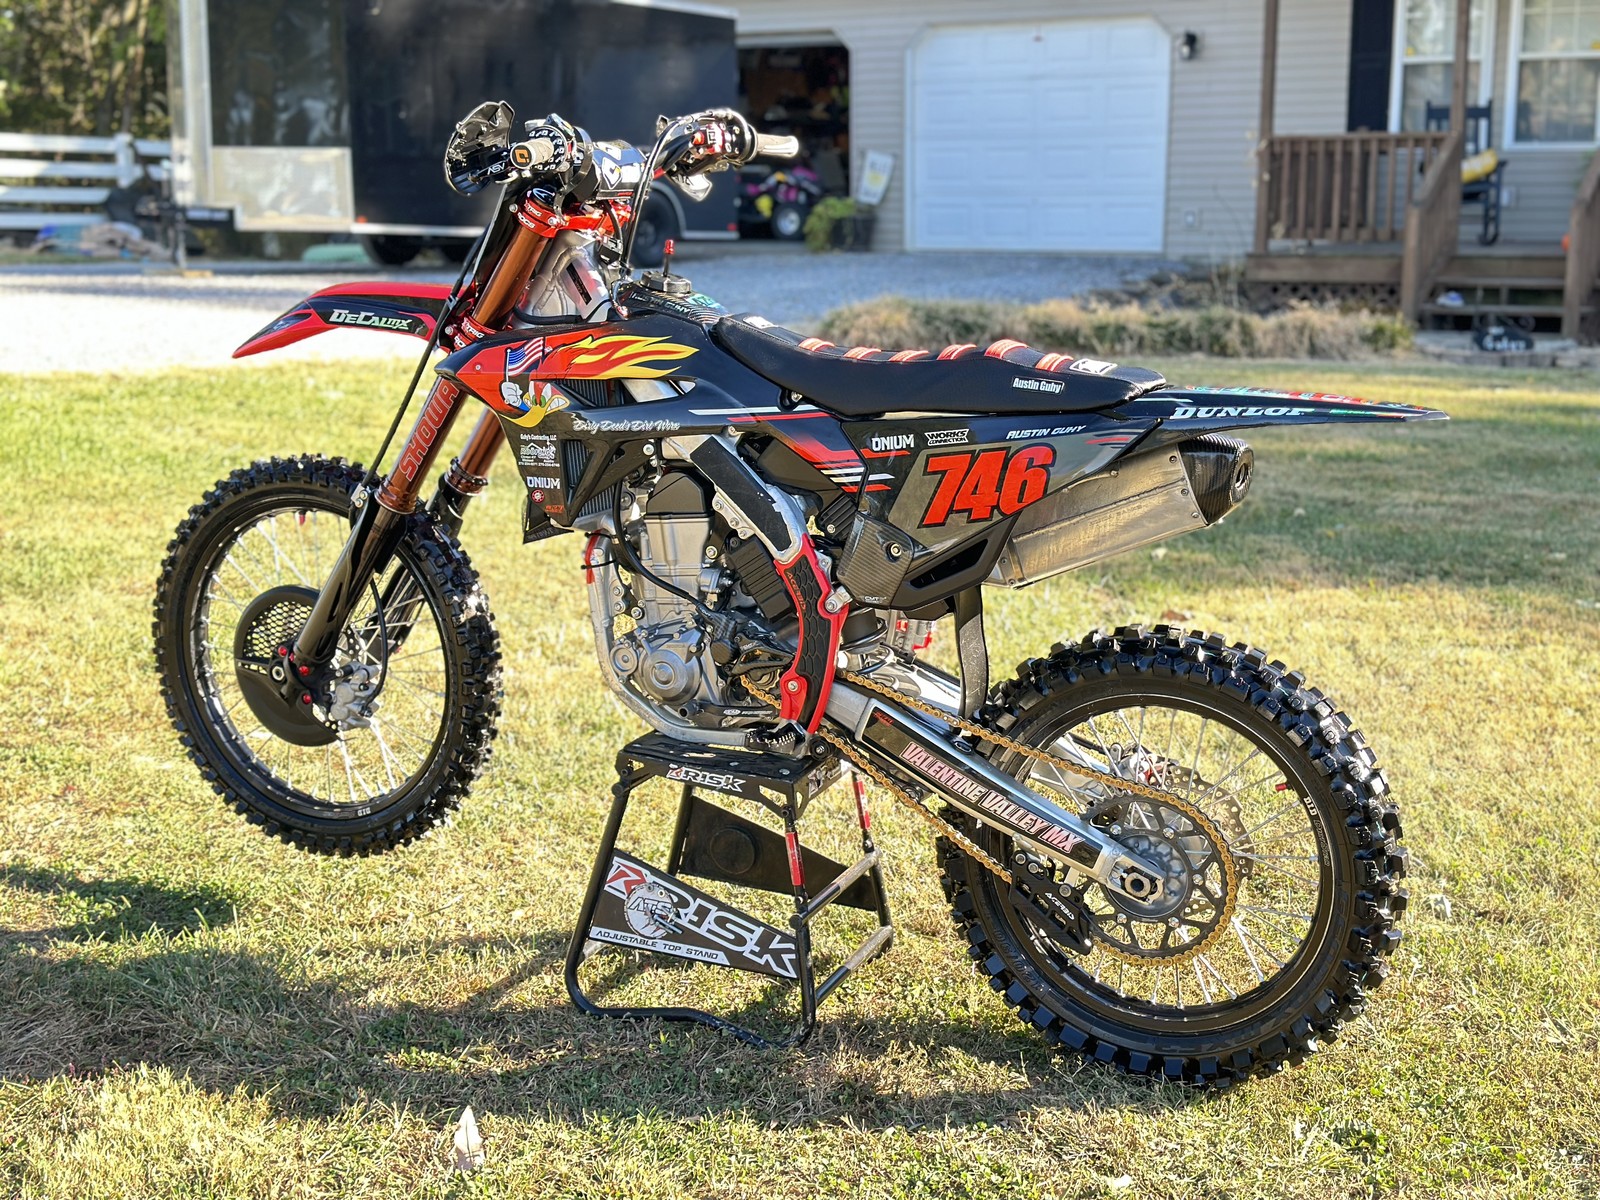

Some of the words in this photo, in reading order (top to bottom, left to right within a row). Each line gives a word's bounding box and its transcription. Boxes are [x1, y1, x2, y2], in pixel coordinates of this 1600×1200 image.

[487, 162, 507, 176] ASV
[1012, 377, 1040, 391] Austin
[1040, 380, 1062, 394] Guhy
[399, 377, 460, 482] SHOWA
[927, 430, 967, 440] WORKS
[1006, 428, 1050, 440] AUSTIN
[1051, 425, 1087, 434] GUHY
[917, 442, 1058, 529] 746
[681, 767, 747, 793] RISK
[901, 741, 987, 803] VALENTINE
[979, 789, 1051, 835] VALLEY
[1038, 823, 1086, 854] MX
[627, 896, 673, 916] ATS
[645, 872, 798, 979] RISK
[596, 930, 658, 948] ADJUSTABLE
[663, 943, 682, 953] TOP
[686, 948, 719, 960] STAND
